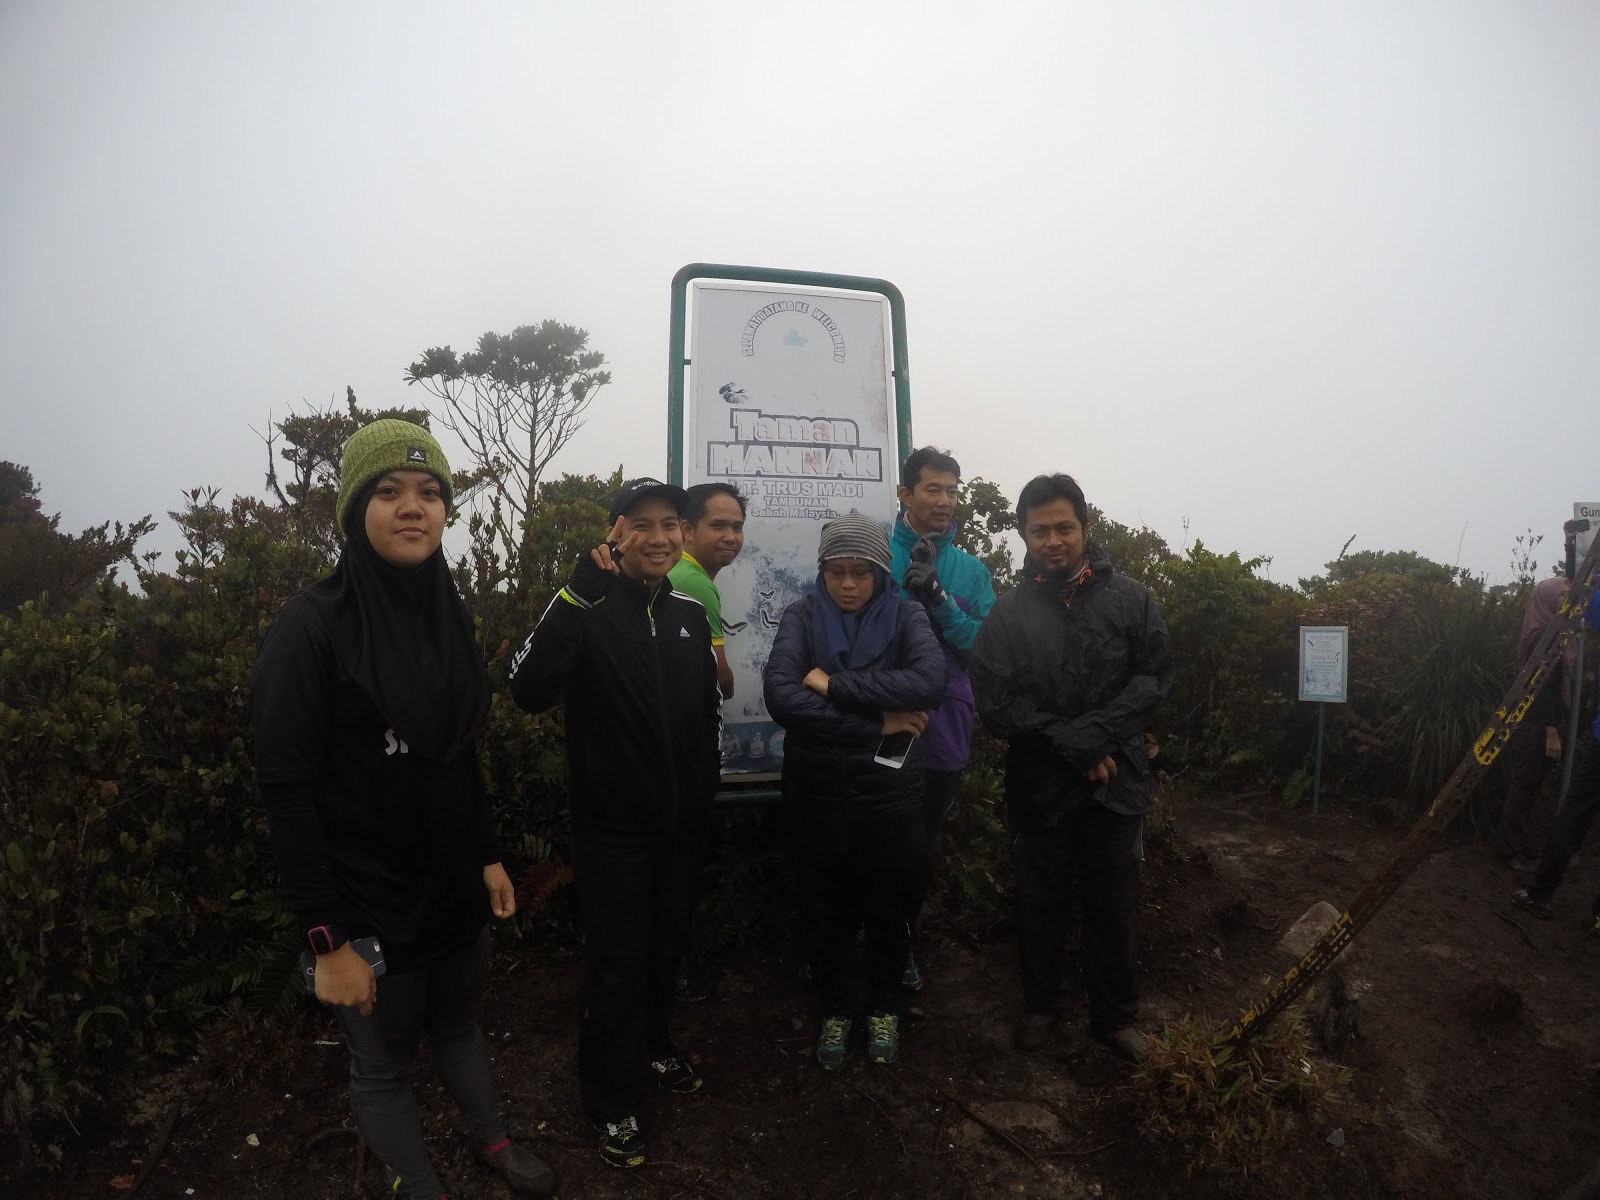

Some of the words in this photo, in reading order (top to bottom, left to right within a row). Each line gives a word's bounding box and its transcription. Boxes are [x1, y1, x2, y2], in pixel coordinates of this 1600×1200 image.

[742, 315, 763, 357] SELAMAT
[756, 301, 794, 321] DATANG
[795, 301, 809, 314] KE
[811, 307, 845, 349] WELCOME
[833, 350, 845, 363] TO
[731, 409, 859, 445] Taman
[708, 442, 882, 481] MANNAN
[763, 481, 813, 496] TRUS
[817, 483, 863, 498] MADI
[764, 496, 828, 507] TAMBUNAN
[752, 507, 788, 518] Sabah
